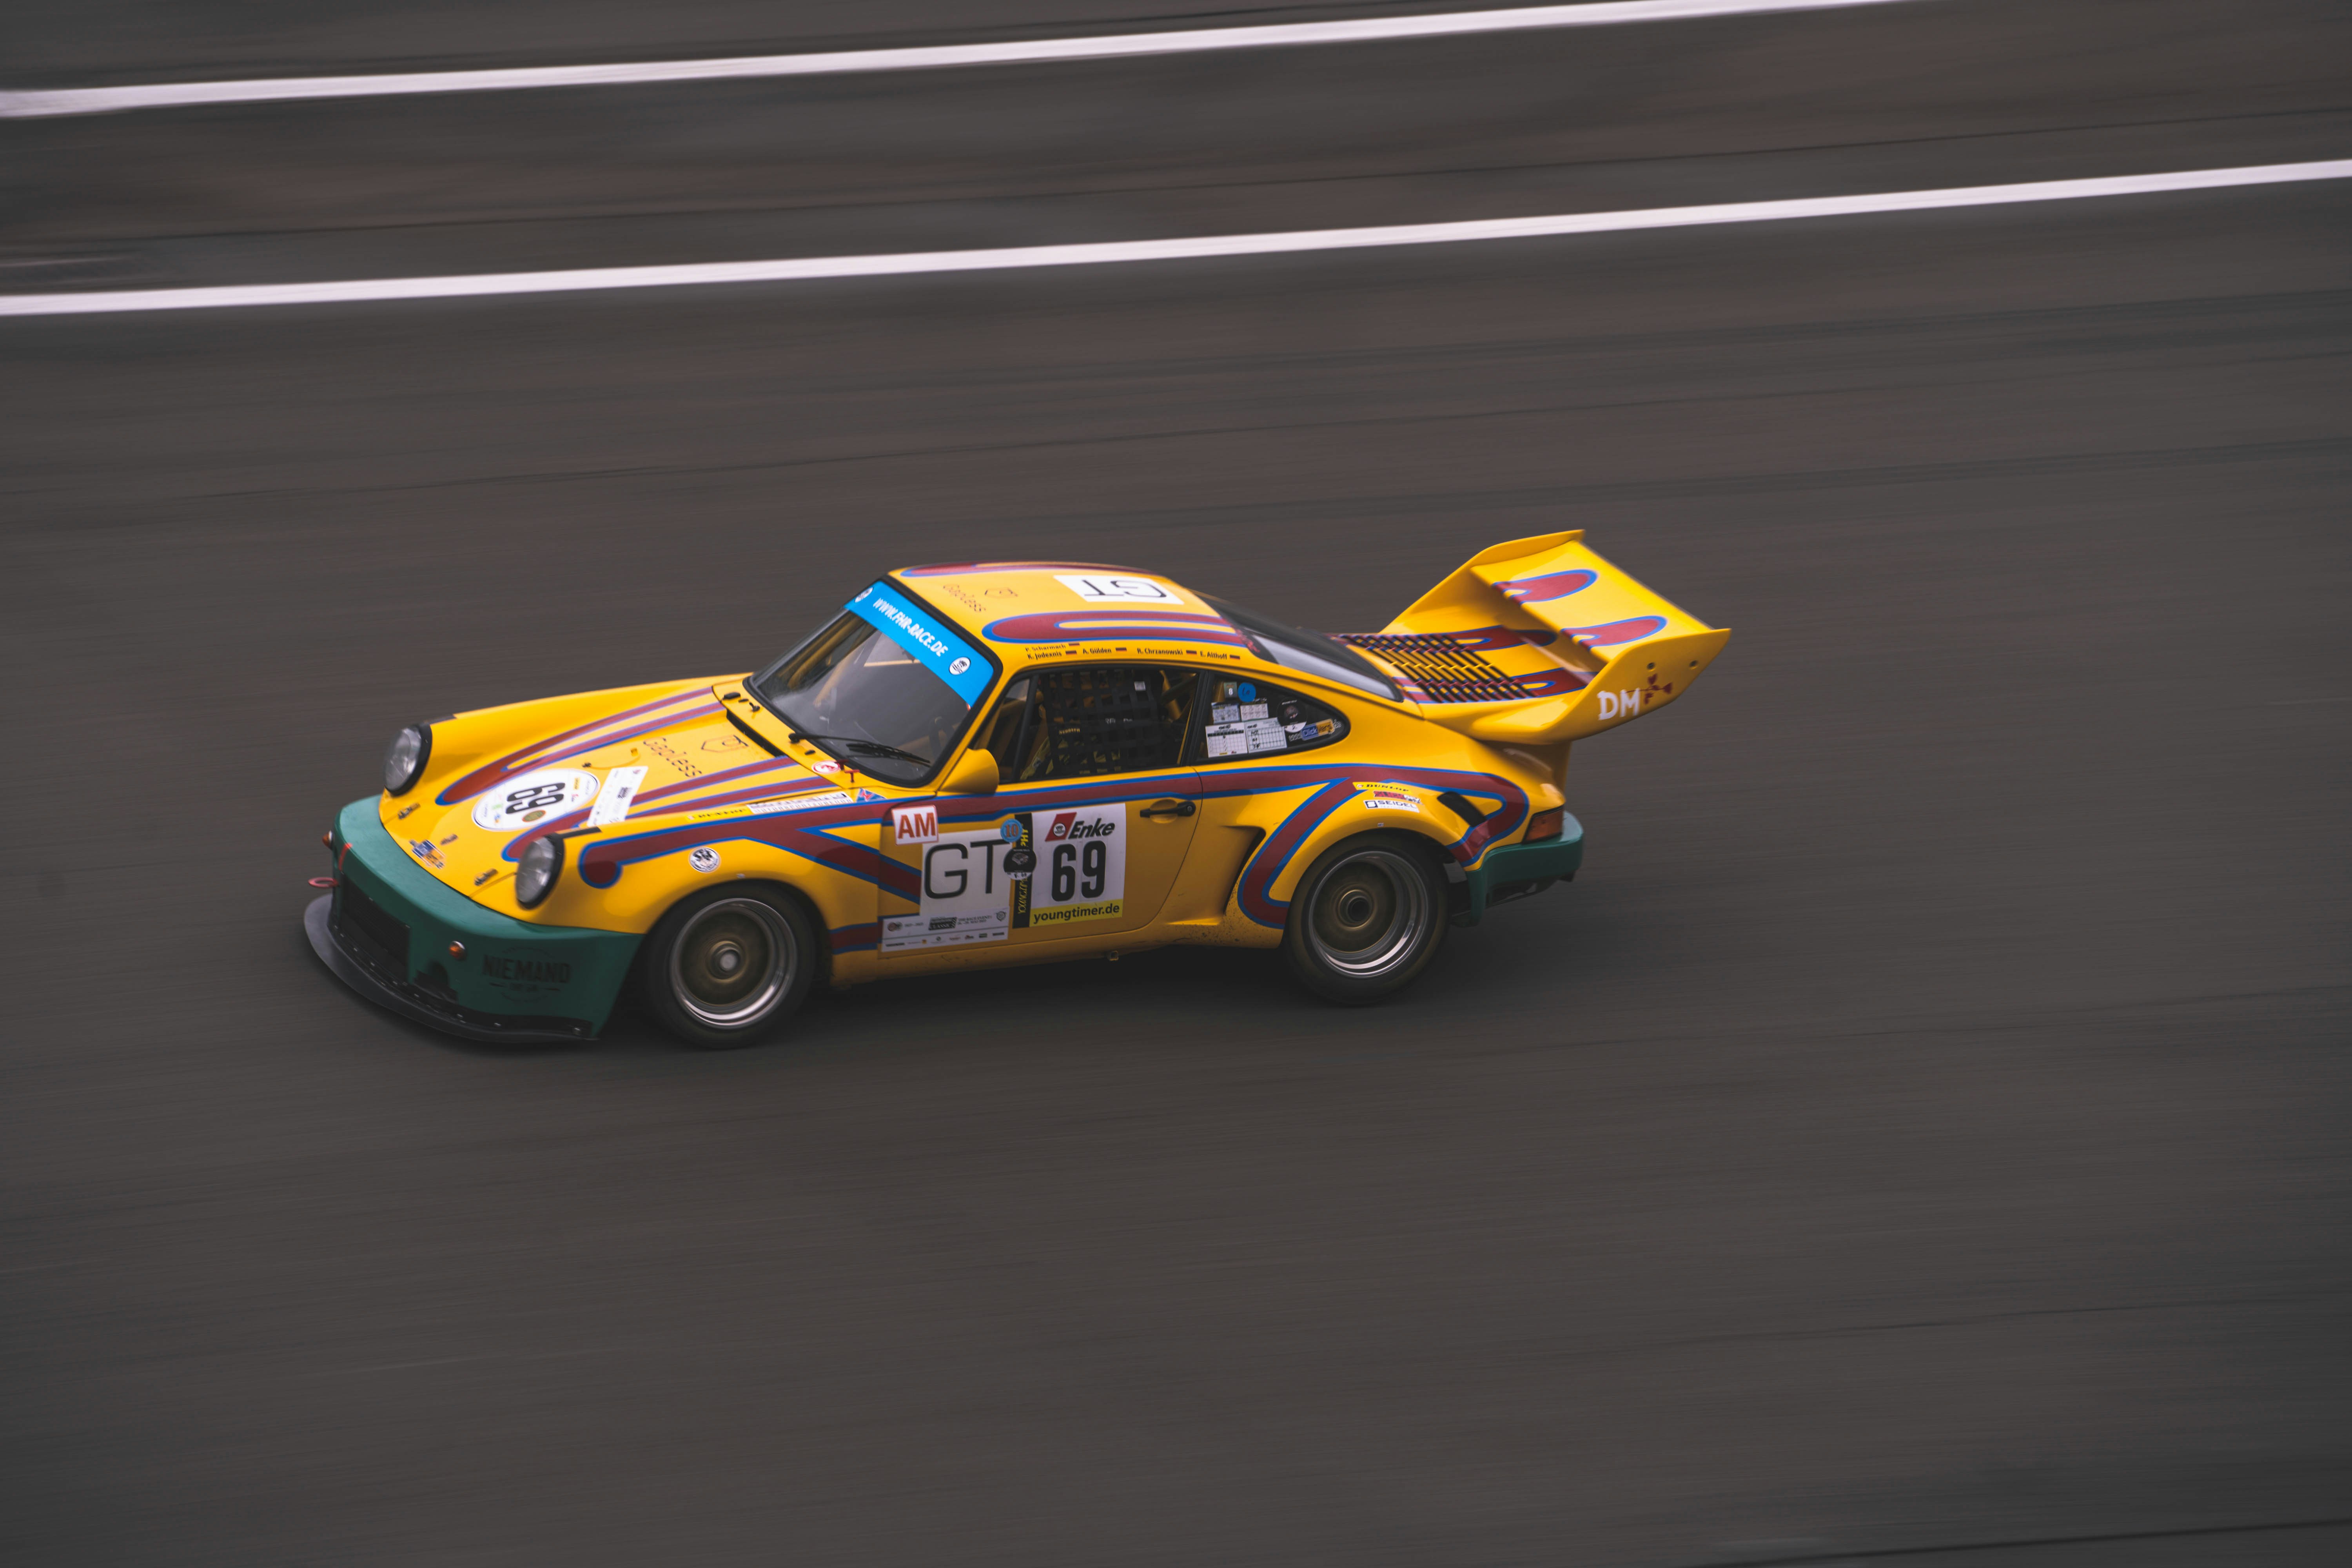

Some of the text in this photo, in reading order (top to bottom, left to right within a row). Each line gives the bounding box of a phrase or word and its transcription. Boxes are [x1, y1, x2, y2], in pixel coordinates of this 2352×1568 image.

[1081, 579, 1167, 599] GT
[873, 597, 949, 657] WWW.FHR-RACE.DE
[1597, 687, 1641, 720] DM
[505, 782, 566, 814] 69
[1377, 800, 1417, 809] SEIDEL
[897, 813, 936, 839] AM
[1005, 824, 1019, 838] 10
[1068, 818, 1115, 839] Enke
[924, 839, 1011, 899] GT
[1051, 840, 1107, 902] 69
[1033, 903, 1120, 924] youngtimer.de
